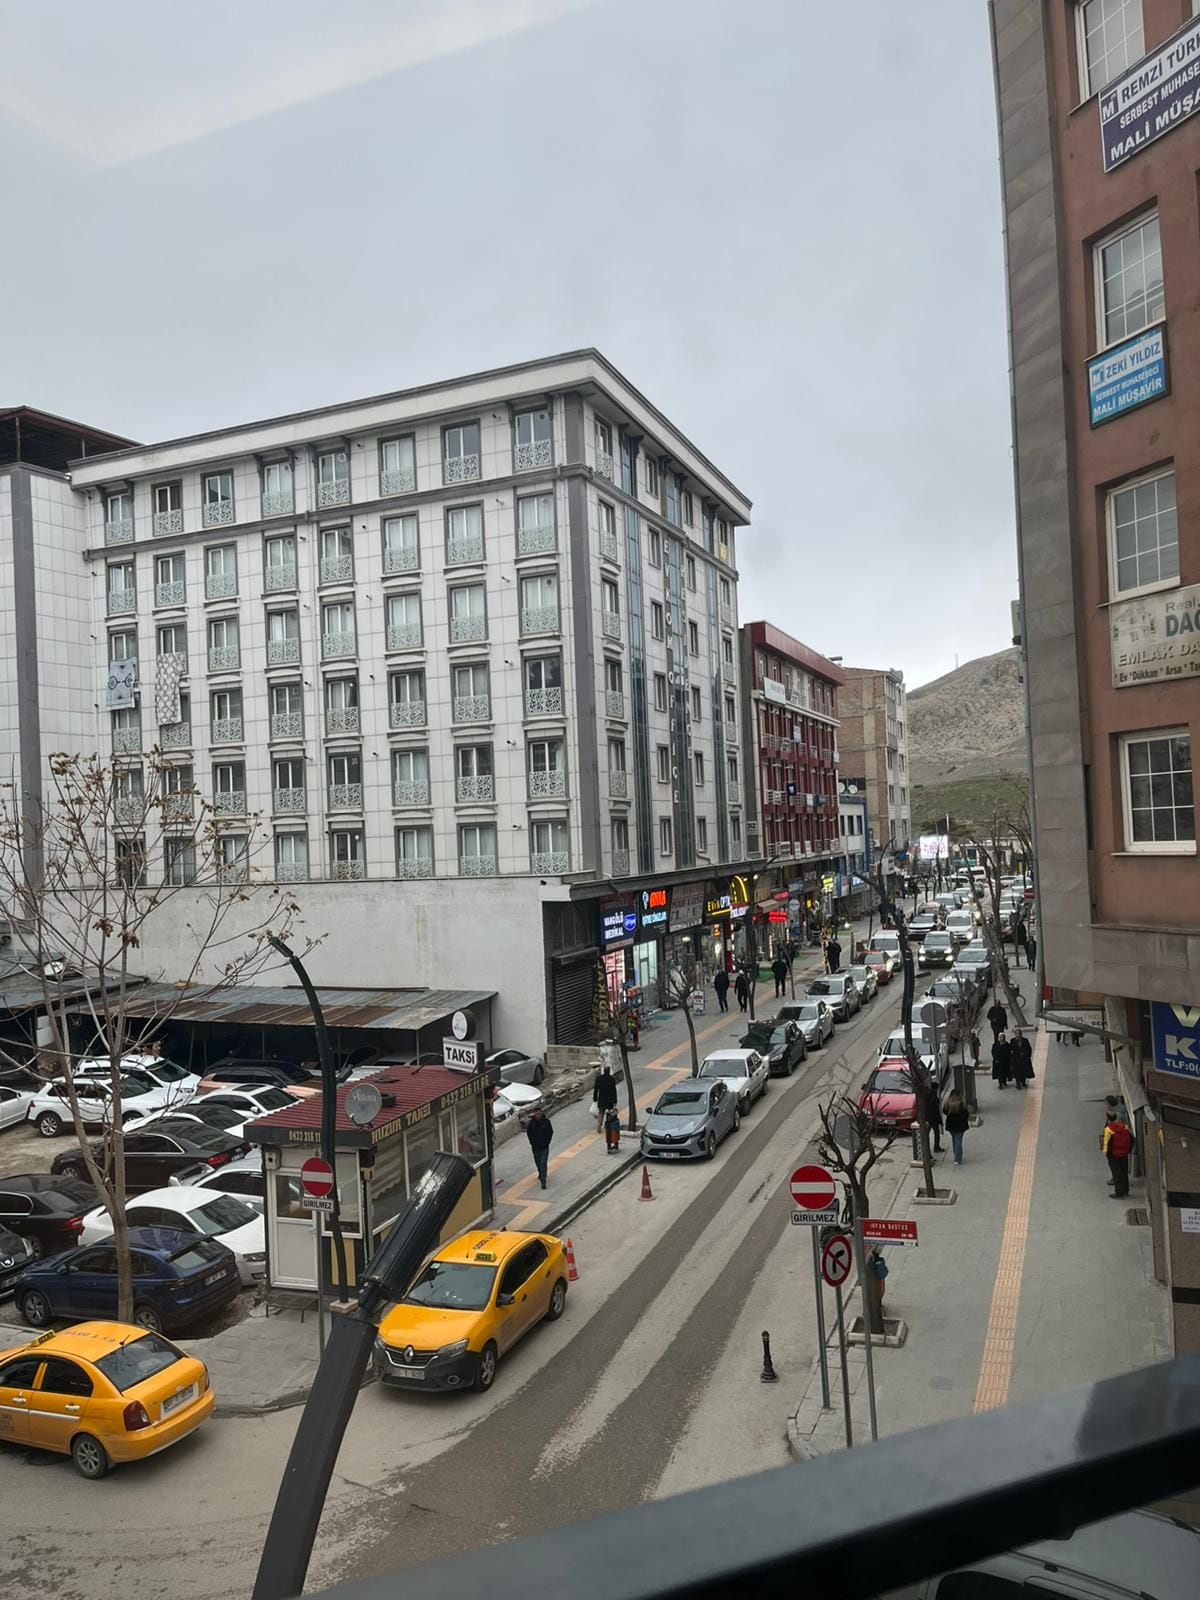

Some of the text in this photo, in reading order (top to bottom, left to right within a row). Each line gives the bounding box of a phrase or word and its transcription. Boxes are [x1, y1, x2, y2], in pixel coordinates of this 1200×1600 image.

[1121, 59, 1163, 104] REMZİ
[1120, 92, 1159, 129] SERBEST
[1111, 121, 1150, 161] MALİ
[1106, 341, 1161, 379] ZEKİ YILDIZ
[1093, 378, 1162, 417] MALİ MÜŞAVİR
